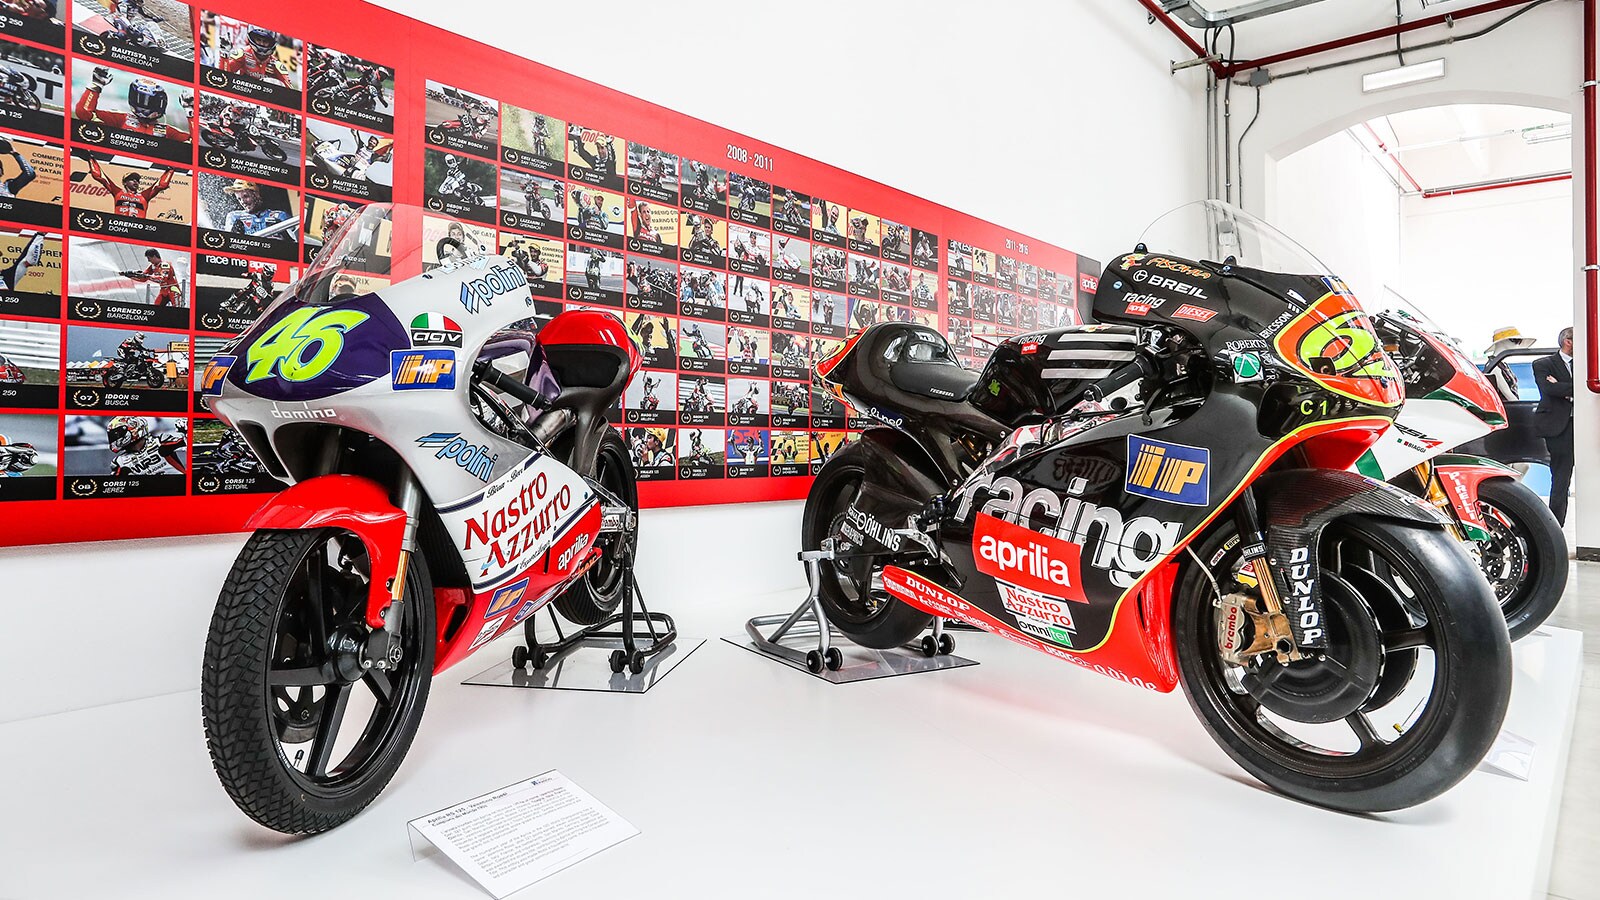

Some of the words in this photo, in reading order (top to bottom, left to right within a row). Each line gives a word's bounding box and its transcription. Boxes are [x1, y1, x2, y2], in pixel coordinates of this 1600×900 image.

[111, 52, 153, 68] BARCELONA
[112, 46, 146, 60] BAUTISTA
[148, 56, 160, 64] 125
[232, 79, 262, 90] LORENZO
[232, 84, 252, 94] ASSEN
[334, 106, 345, 114] VAN
[358, 112, 376, 120] BOSCH
[110, 132, 145, 144] LORENZO
[146, 140, 158, 148] 250
[110, 138, 138, 150] SEPANG
[232, 158, 244, 166] VAN
[260, 164, 280, 172] BOSCH
[727, 144, 748, 163] 2008
[754, 153, 774, 172] 2011
[231, 164, 247, 172] SANT
[248, 167, 270, 176] WENDEL
[333, 180, 358, 189] BAUTISTA
[109, 219, 144, 230] LORENZO
[145, 224, 156, 232] 250
[109, 225, 128, 234] DOHA
[230, 238, 260, 248] TALMACSI
[206, 254, 230, 265] race
[232, 258, 248, 268] me
[469, 260, 527, 306] polini
[1148, 275, 1209, 300] BREIL
[1122, 292, 1166, 309] racing
[106, 306, 142, 314] LORENZO
[106, 313, 148, 322] BARCELONA
[1128, 304, 1148, 316] aprilia
[1177, 306, 1212, 320] DIESEL
[1258, 311, 1294, 340] ERICSSON
[246, 306, 370, 384] 46
[412, 332, 462, 344] agv
[271, 402, 336, 418] domino
[1301, 400, 1314, 416] C
[1320, 400, 1328, 416] 1
[1408, 442, 1426, 453] BIAGGI
[436, 437, 498, 483] polini
[1449, 472, 1476, 520] PIRELLI
[464, 472, 548, 550] Nastro
[480, 484, 570, 578] Azzurro
[864, 513, 902, 552] ÖHLINS
[954, 474, 1184, 588] racing
[558, 533, 589, 570] aprilia
[980, 535, 1071, 588] aprilia
[906, 576, 970, 611] DUNLOP
[1005, 587, 1062, 613] Nastro
[1290, 547, 1322, 645] DUNLOP
[1006, 602, 1070, 626] Azzurro
[1018, 620, 1070, 645] omnitel
[1225, 607, 1238, 650] brembo
